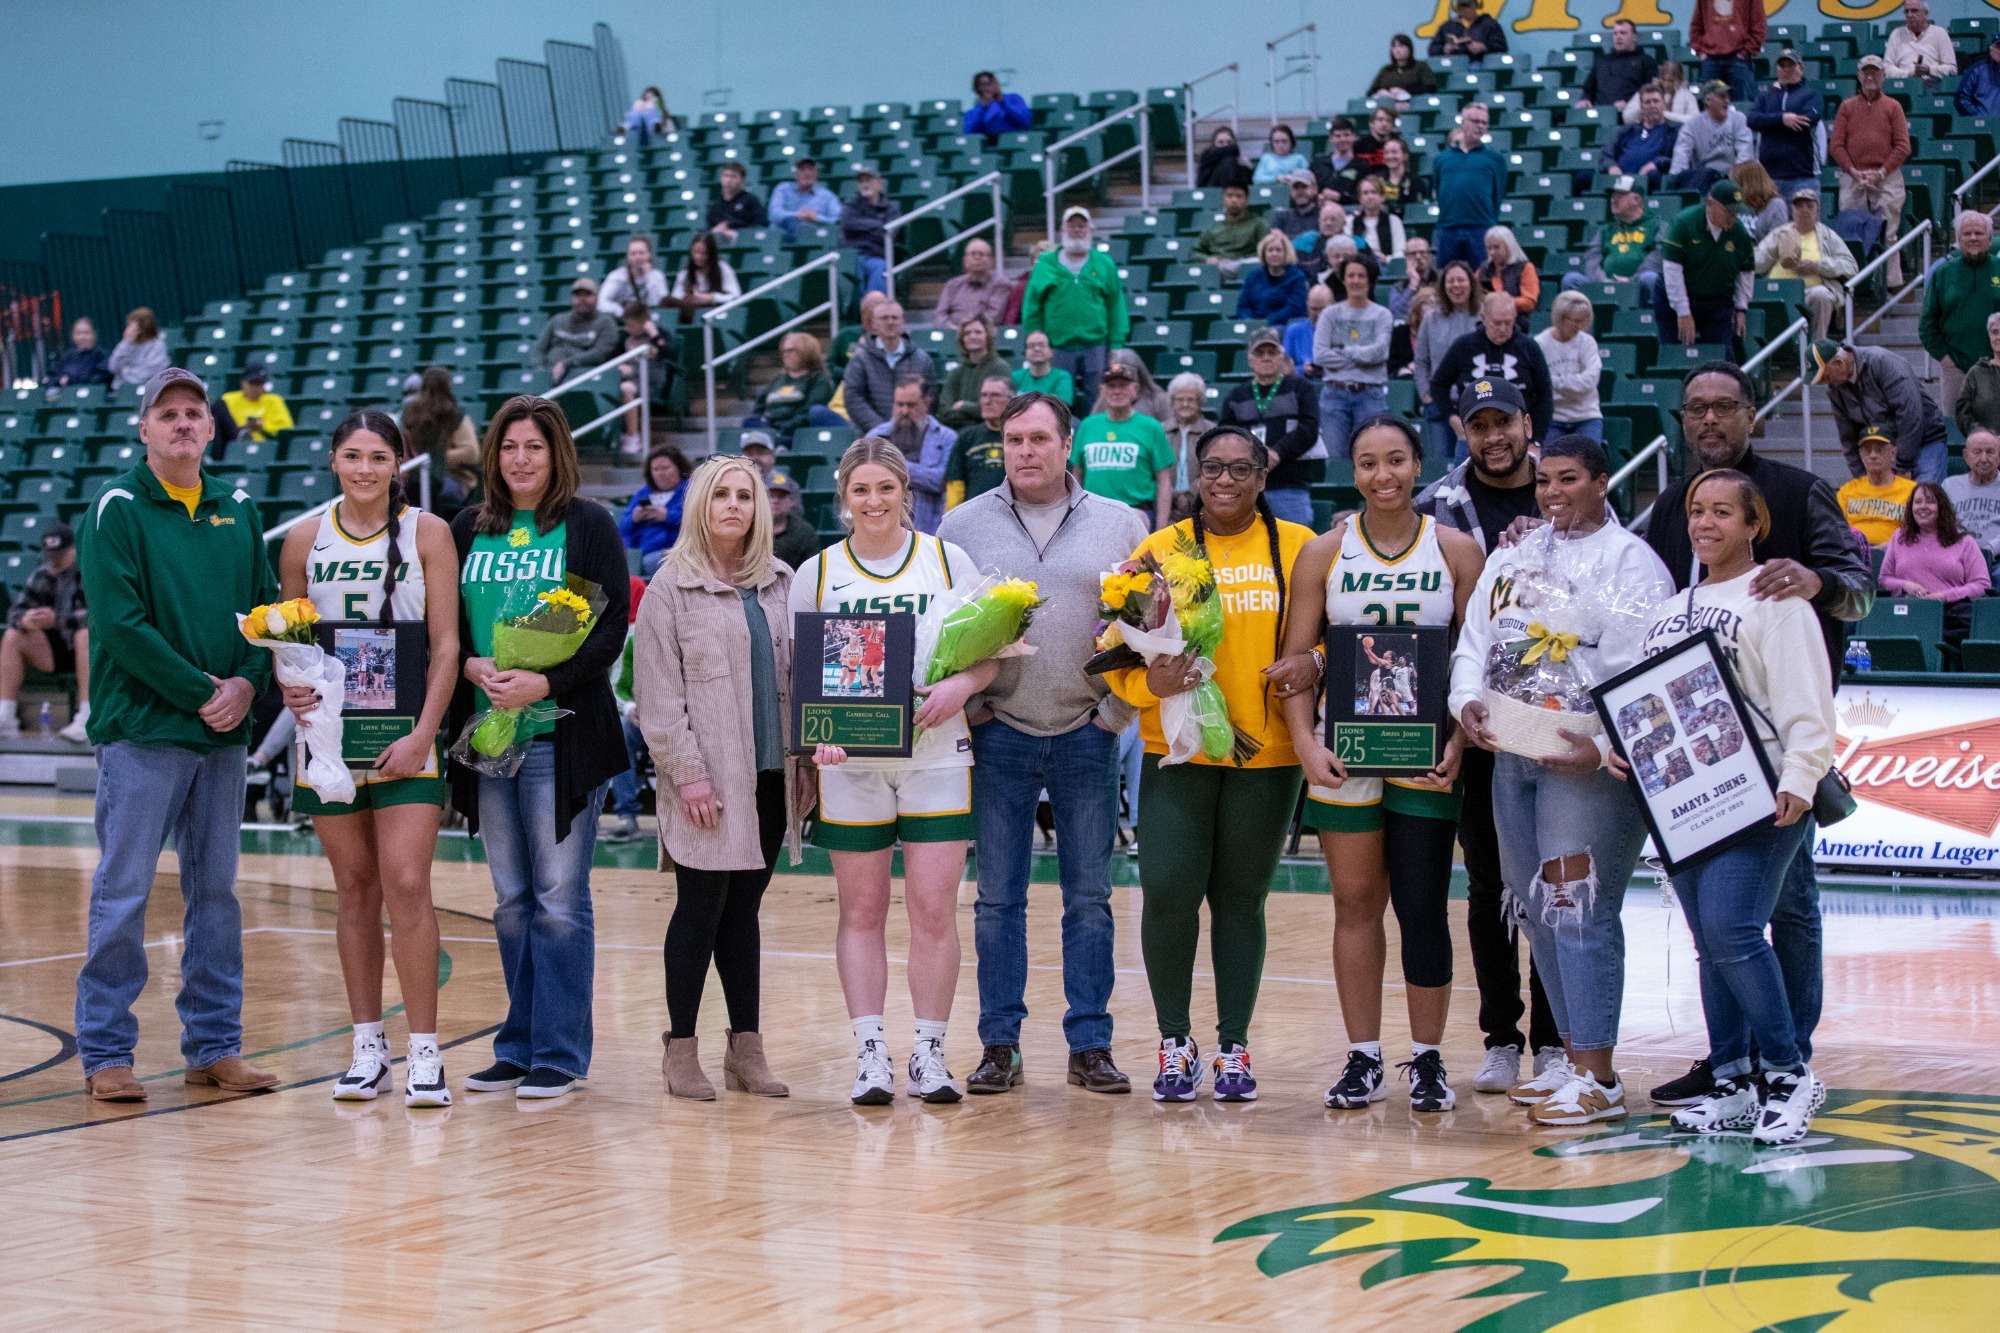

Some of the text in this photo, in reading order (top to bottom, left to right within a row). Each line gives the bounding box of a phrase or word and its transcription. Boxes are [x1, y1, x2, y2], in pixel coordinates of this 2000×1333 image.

[1086, 445, 1135, 465] LIONS
[1954, 498, 2000, 515] OUTHER
[461, 547, 563, 585] MSSU
[1340, 571, 1442, 593] MSSU
[342, 591, 370, 621] 5
[806, 716, 834, 742] 20
[1616, 661, 1744, 798] 25
[1339, 736, 1366, 762] 25
[1670, 773, 1748, 819] AMAYA JOHNS
[1690, 804, 1716, 821] SOUTHERN
[1715, 797, 1730, 807] STATE
[1690, 815, 1714, 831] CLASS
[1716, 809, 1727, 818] OF
[1814, 838, 1999, 865] American Lager
